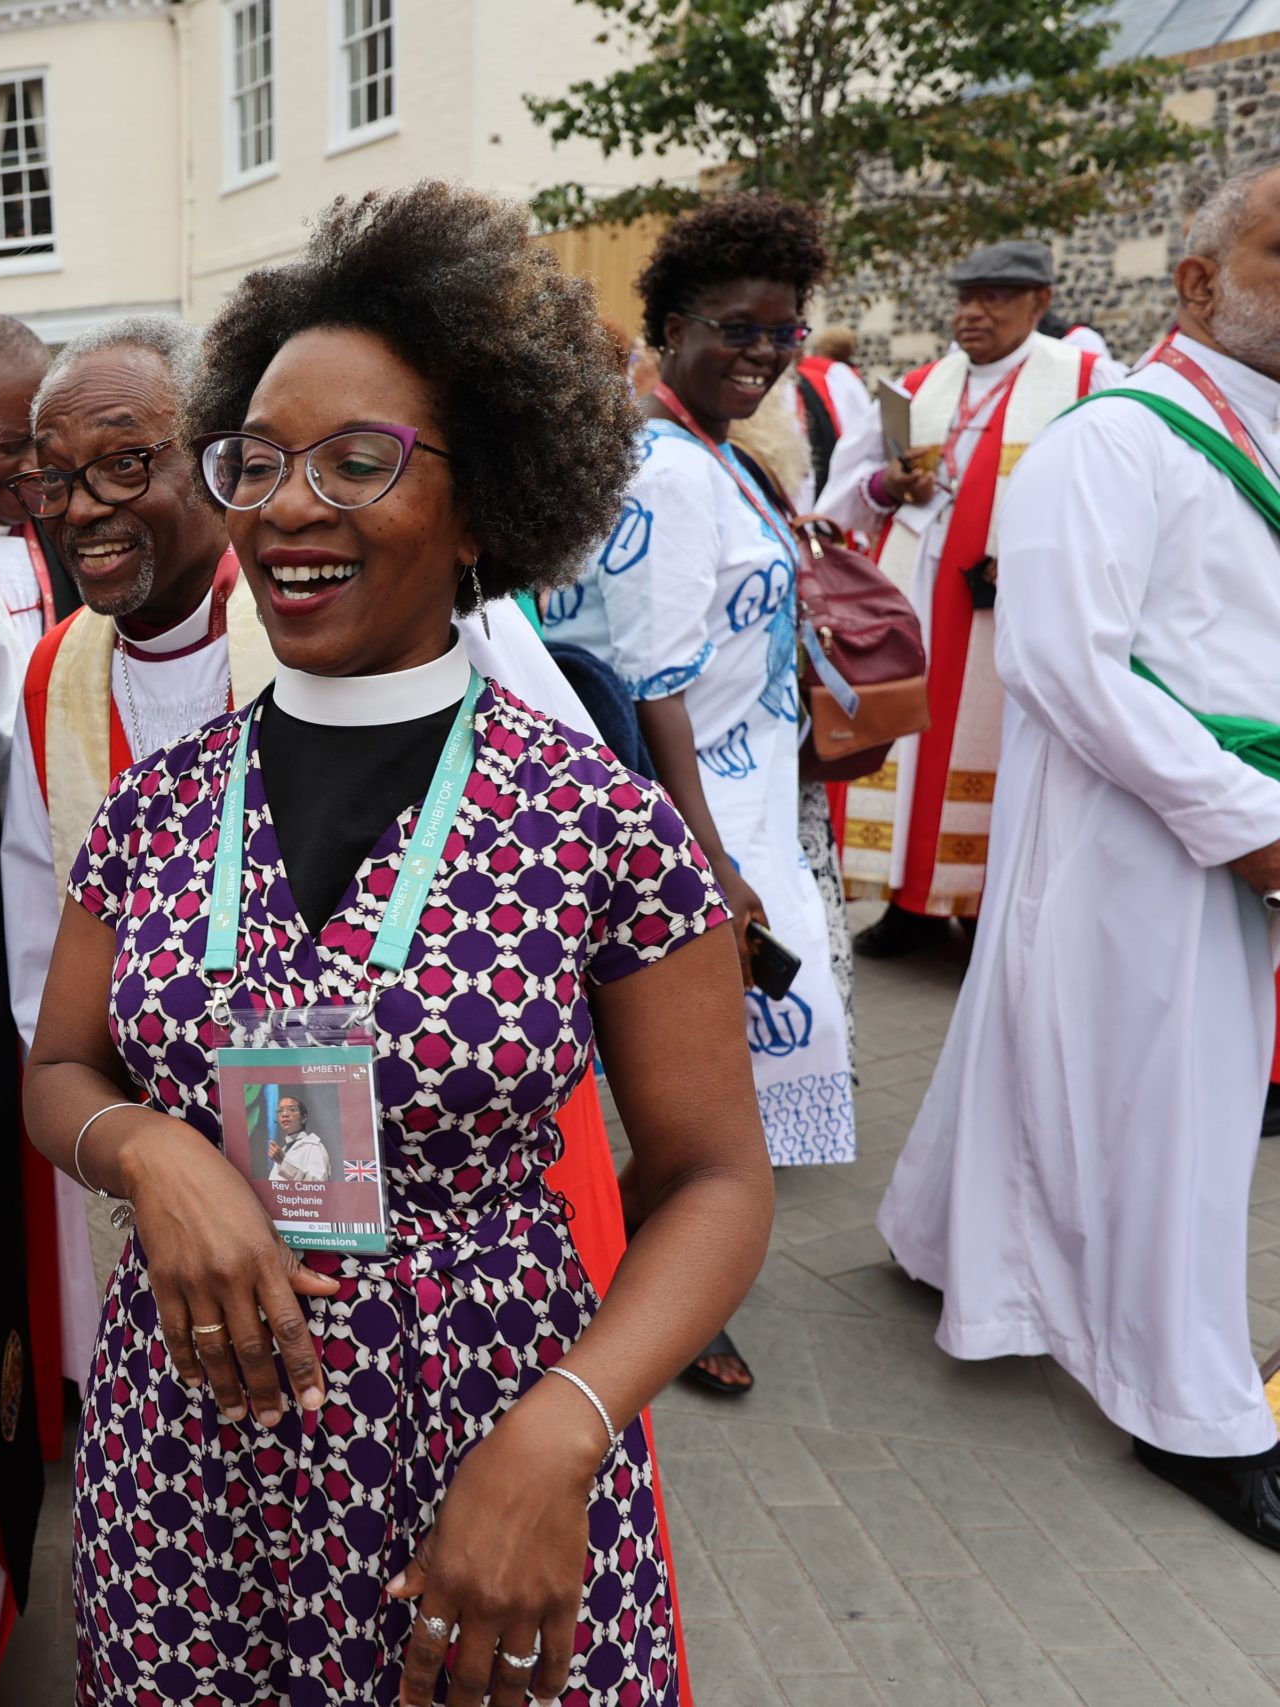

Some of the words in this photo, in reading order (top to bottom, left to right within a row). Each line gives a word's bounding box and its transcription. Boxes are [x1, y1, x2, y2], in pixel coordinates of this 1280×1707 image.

[442, 729, 463, 771] LAMBETH
[223, 790, 238, 854] EXHIBITOR
[422, 779, 455, 849] EXHIBITOR
[226, 860, 236, 907] LAMBETH
[388, 879, 412, 928] LAMBETH
[301, 1064, 346, 1074] LAMBETH
[271, 1181, 293, 1191] Rev.
[294, 1182, 326, 1192] Canon
[276, 1194, 323, 1206] Stephanie
[281, 1207, 320, 1218] Spellers
[292, 1234, 358, 1247] Commissions
